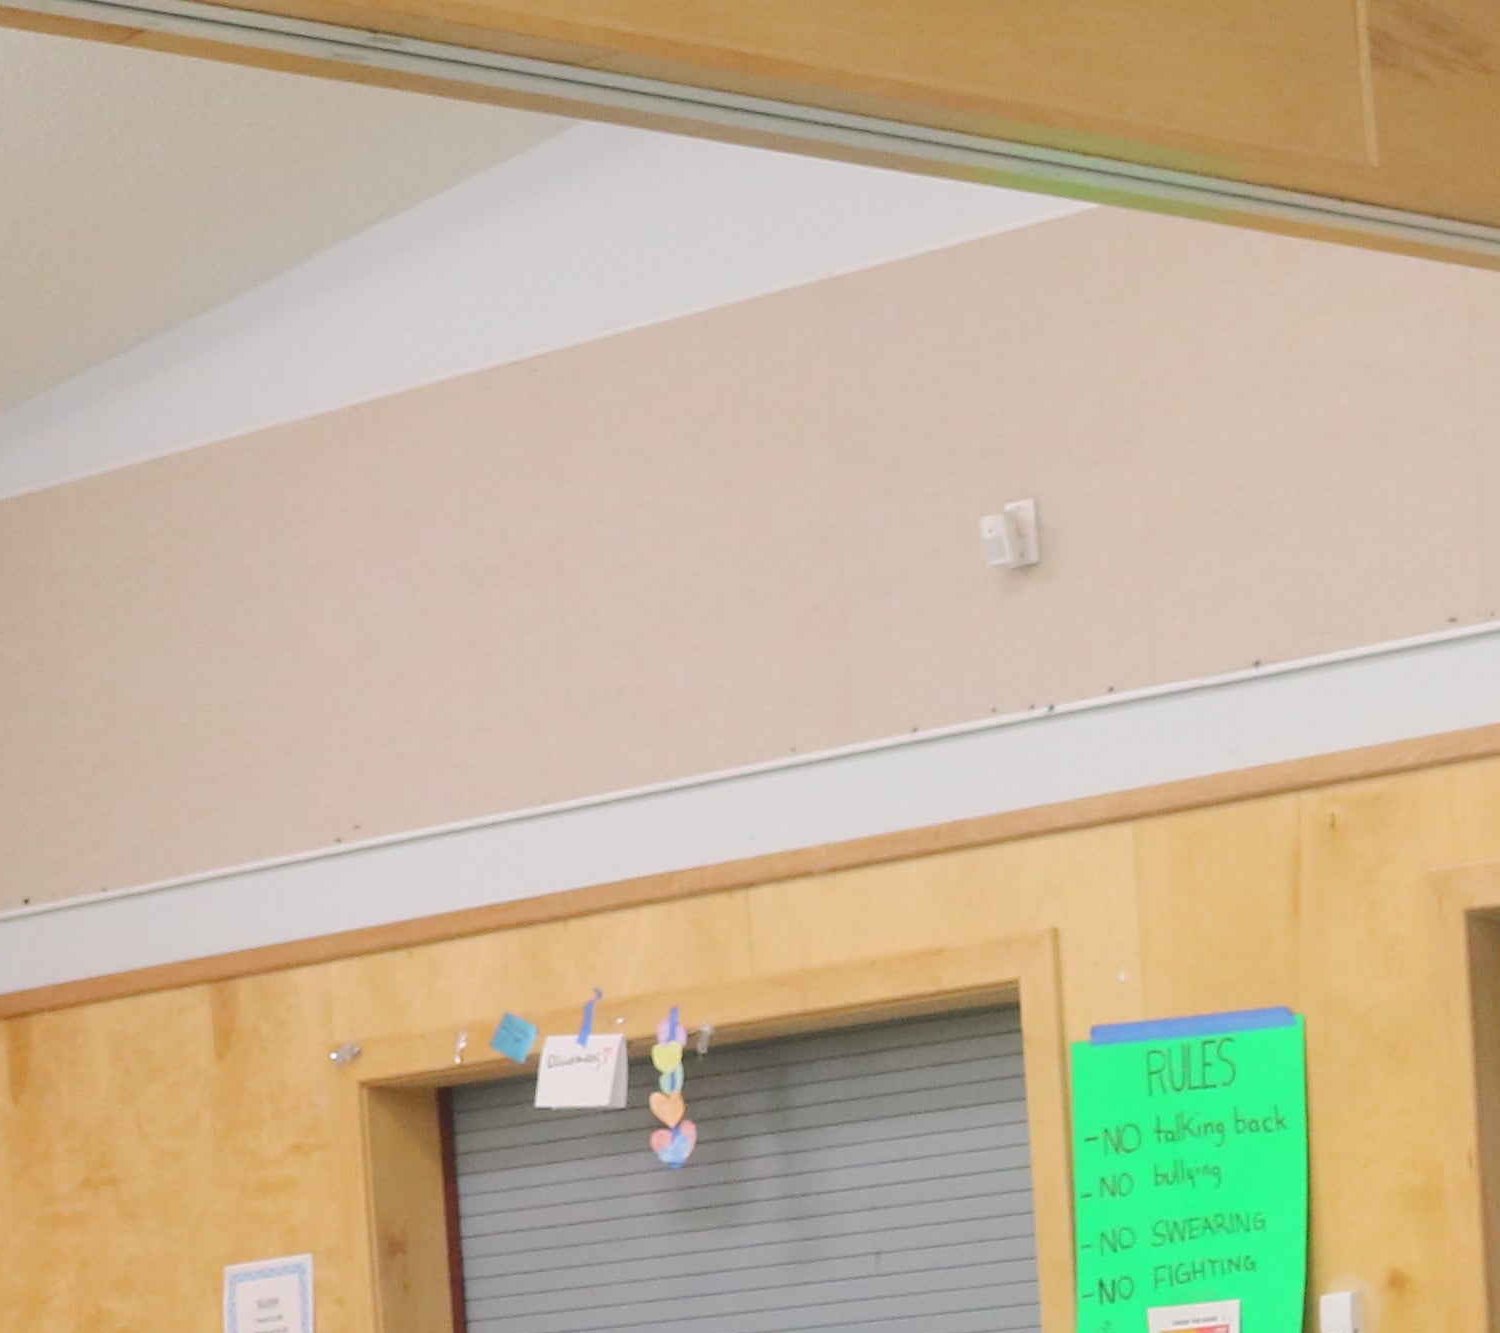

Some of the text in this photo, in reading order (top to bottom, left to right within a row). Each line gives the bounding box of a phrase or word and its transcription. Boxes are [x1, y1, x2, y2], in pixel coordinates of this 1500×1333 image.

[1145, 1036, 1237, 1097] RULES
[1153, 1110, 1226, 1148] talking
[1234, 1104, 1288, 1135] back
[1153, 1160, 1223, 1189] bullying
[1151, 1211, 1267, 1248] SWEARING
[1153, 1254, 1257, 1290] FIGHTING
